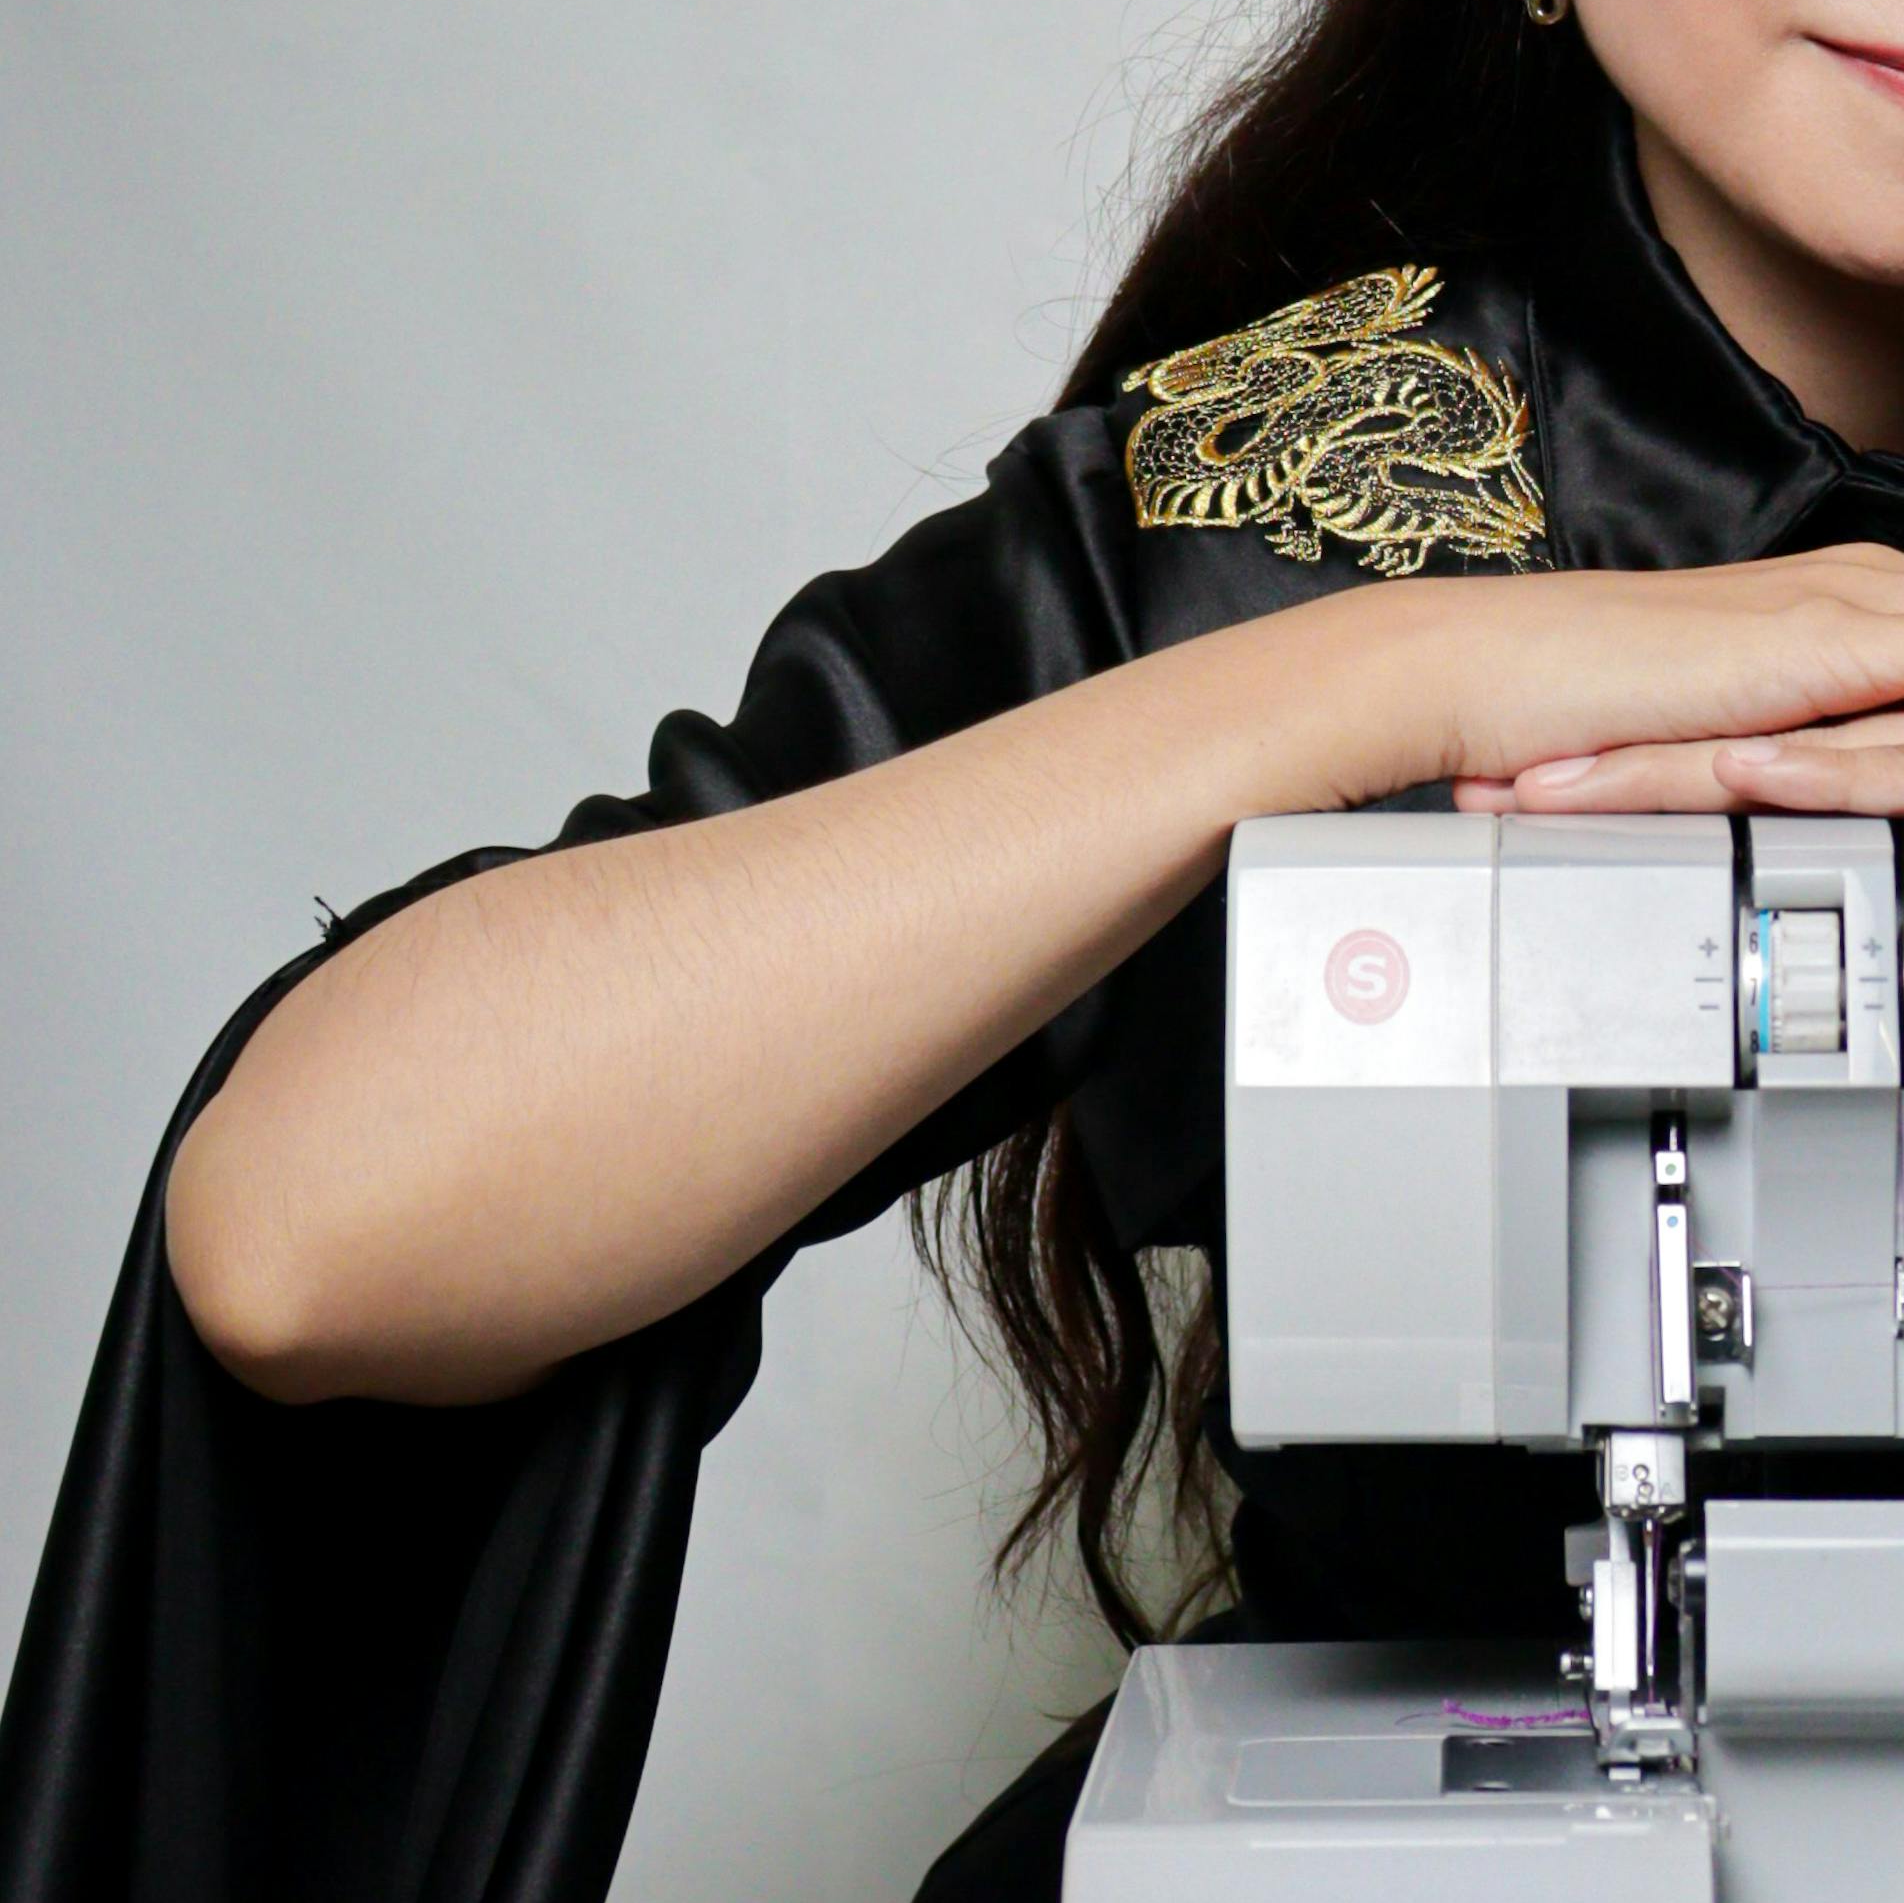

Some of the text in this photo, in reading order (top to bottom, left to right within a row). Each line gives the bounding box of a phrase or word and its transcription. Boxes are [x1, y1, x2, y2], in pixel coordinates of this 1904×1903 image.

[1750, 932, 1759, 954] 6
[1346, 953, 1388, 1001] S
[1750, 978, 1759, 1006] 7
[1750, 1029, 1760, 1054] 8
